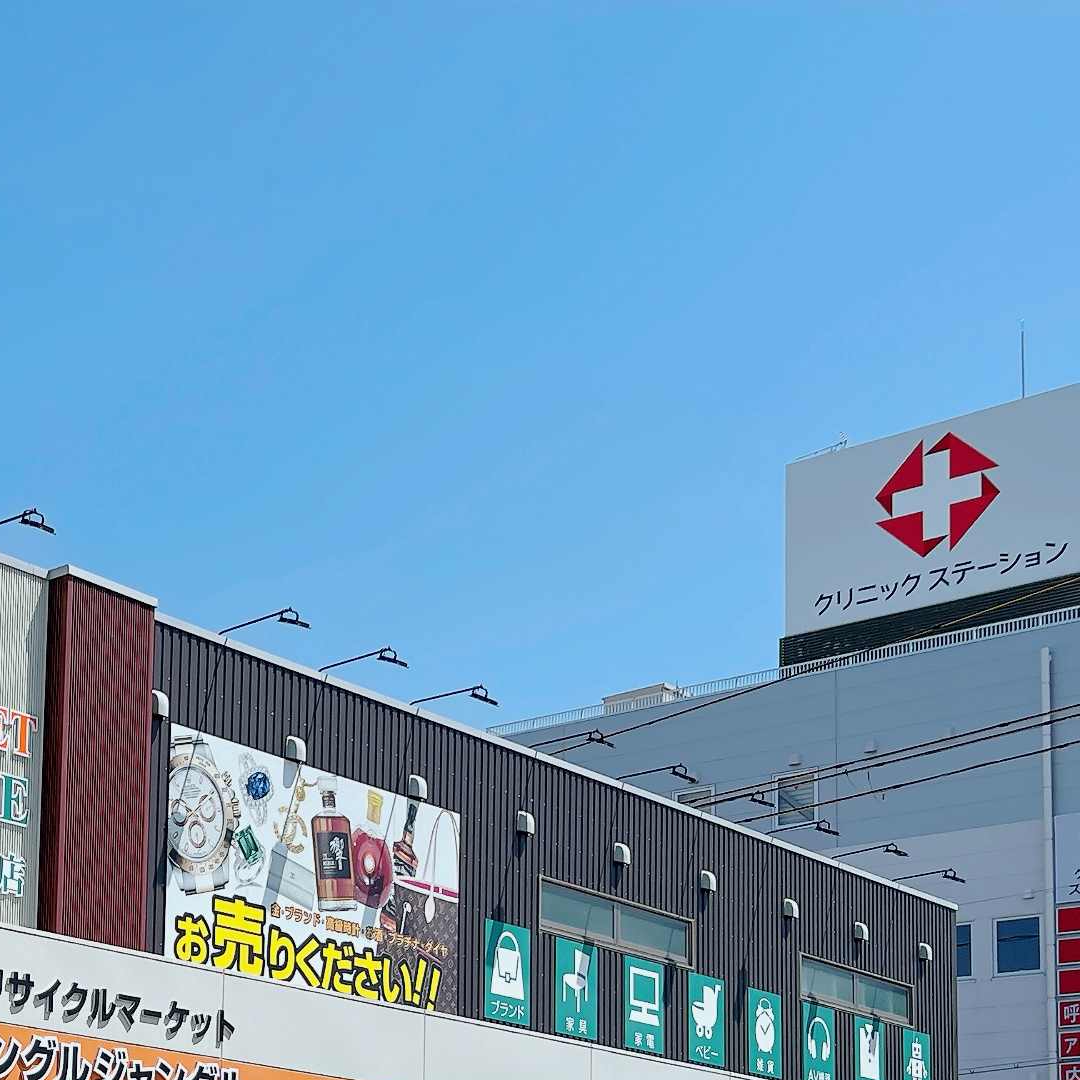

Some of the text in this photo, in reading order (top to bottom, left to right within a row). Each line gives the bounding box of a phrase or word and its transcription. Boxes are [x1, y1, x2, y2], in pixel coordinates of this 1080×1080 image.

[490, 1001, 525, 1020] ブランド
[695, 1045, 719, 1060] ベビー
